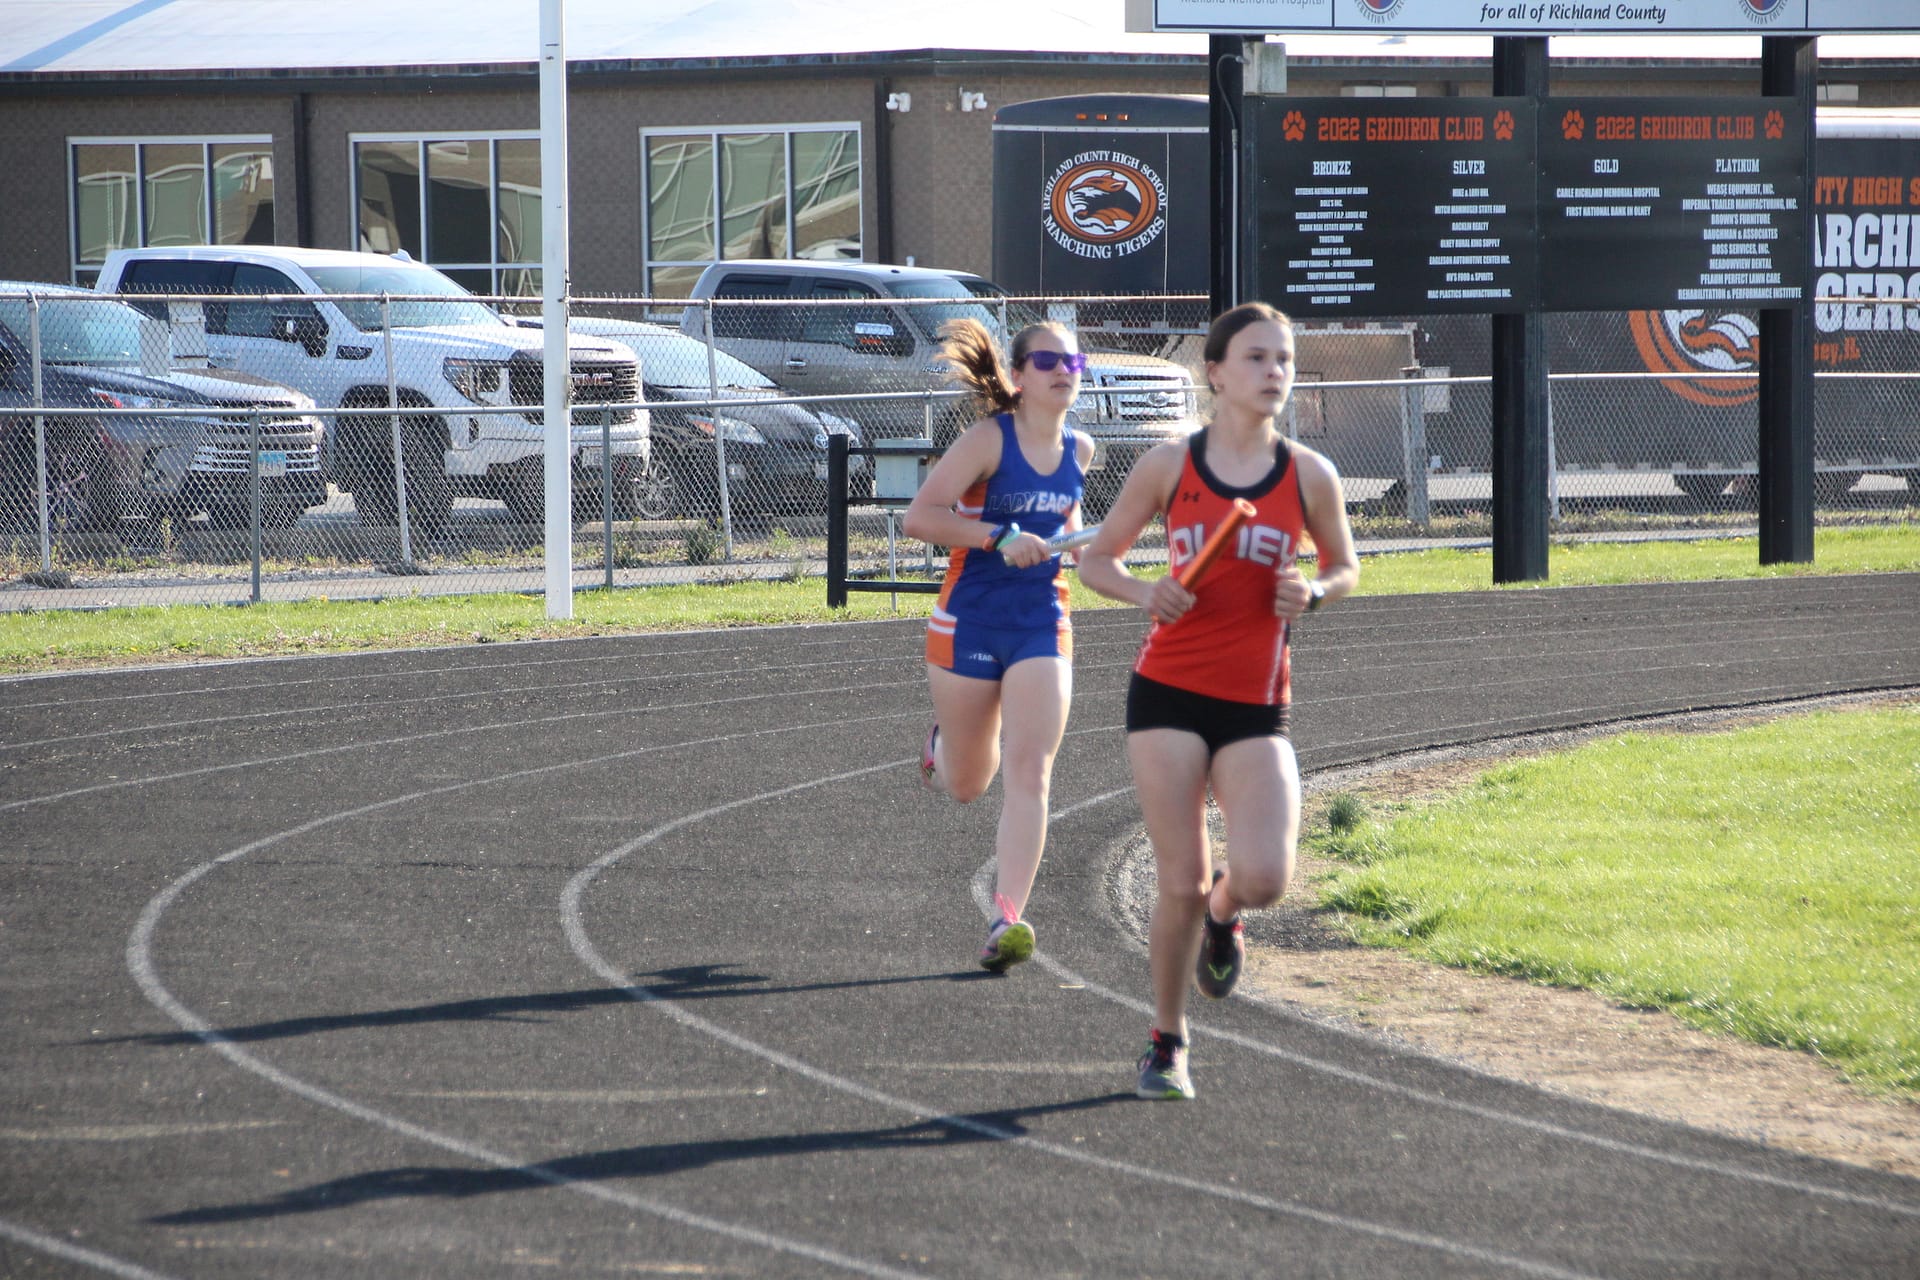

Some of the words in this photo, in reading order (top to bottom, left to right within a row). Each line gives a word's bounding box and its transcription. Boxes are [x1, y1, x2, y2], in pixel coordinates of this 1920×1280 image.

[1480, 3, 1503, 23] for
[1508, 4, 1525, 19] all
[1530, 3, 1546, 23] of
[1549, 4, 1612, 20] Richland
[1616, 4, 1666, 24] County
[1318, 117, 1361, 141] 2022
[1366, 117, 1440, 141] GRIDIRON
[1445, 117, 1484, 141] CLUB
[1595, 116, 1636, 140] 2022
[1640, 116, 1712, 140] GRIDIRON
[1716, 116, 1755, 140] CLUB
[1313, 161, 1352, 176] BRONZE
[1453, 160, 1486, 174] SILVER
[1594, 159, 1619, 173] GOLD
[1715, 159, 1760, 173] PLATINUM
[1043, 158, 1073, 211] RICHLAND
[1074, 150, 1111, 165] COUNTY
[1111, 151, 1141, 168] HIGH
[1140, 164, 1169, 211] SCHOOL
[1852, 176, 1903, 206] HIGH
[1043, 214, 1112, 259] MARCHING
[1115, 216, 1166, 257] TIGERS
[1742, 228, 1778, 240] ASSOCIATES
